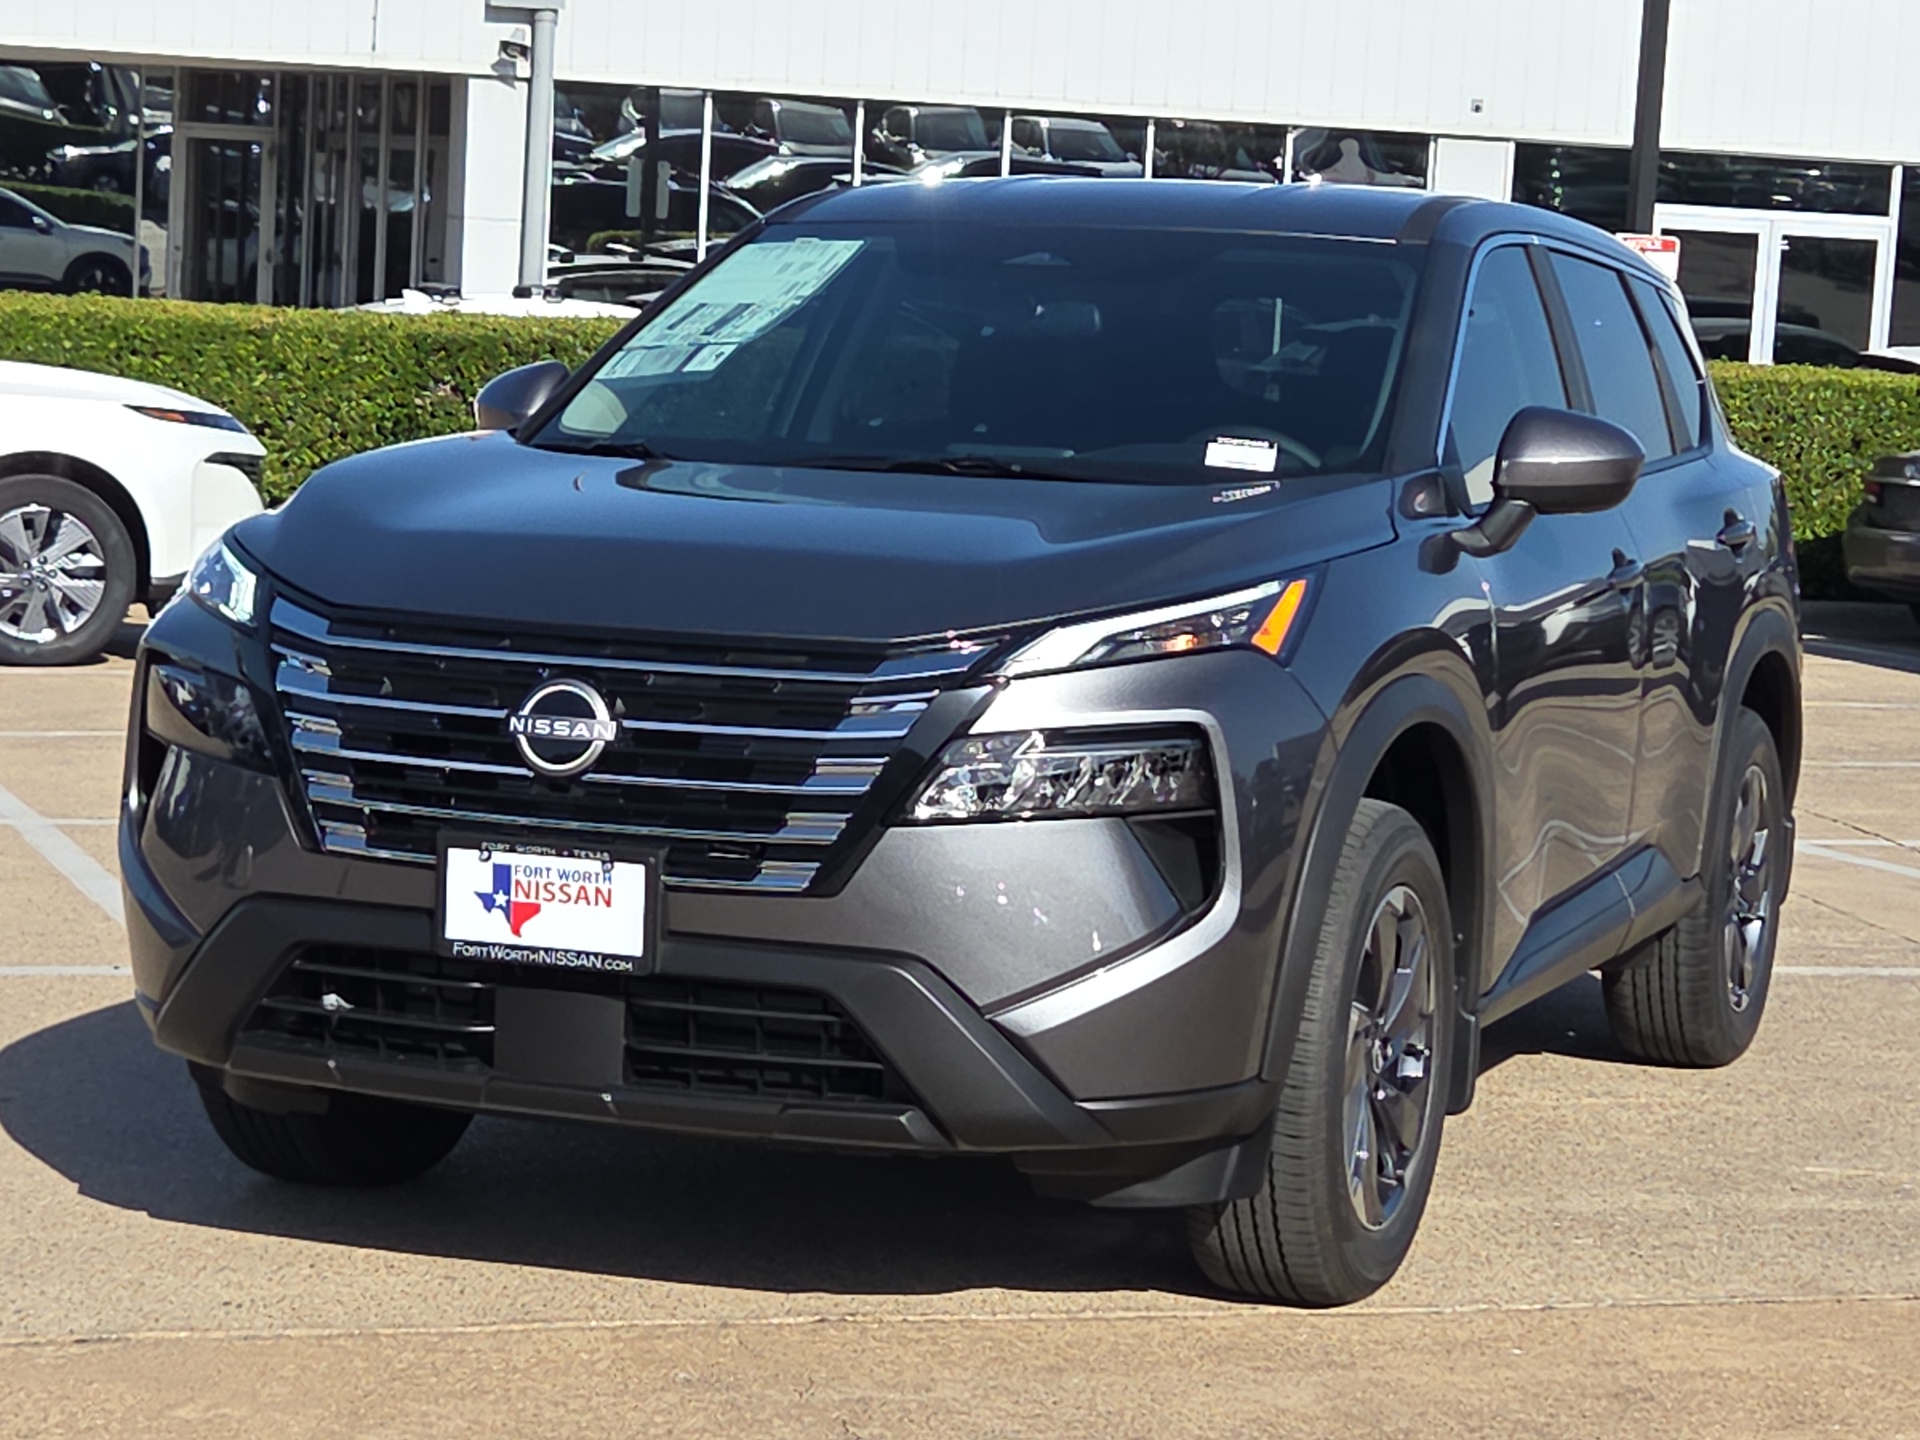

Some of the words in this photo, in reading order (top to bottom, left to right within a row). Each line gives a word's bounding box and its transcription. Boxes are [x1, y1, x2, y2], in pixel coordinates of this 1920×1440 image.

[509, 716, 615, 740] NISSAN
[482, 842, 511, 852] FORT
[515, 845, 556, 856] WORTH
[572, 849, 611, 861] TEXAS
[514, 865, 553, 880] FORT
[557, 868, 612, 885] WORTH
[514, 879, 612, 908] NISSAN
